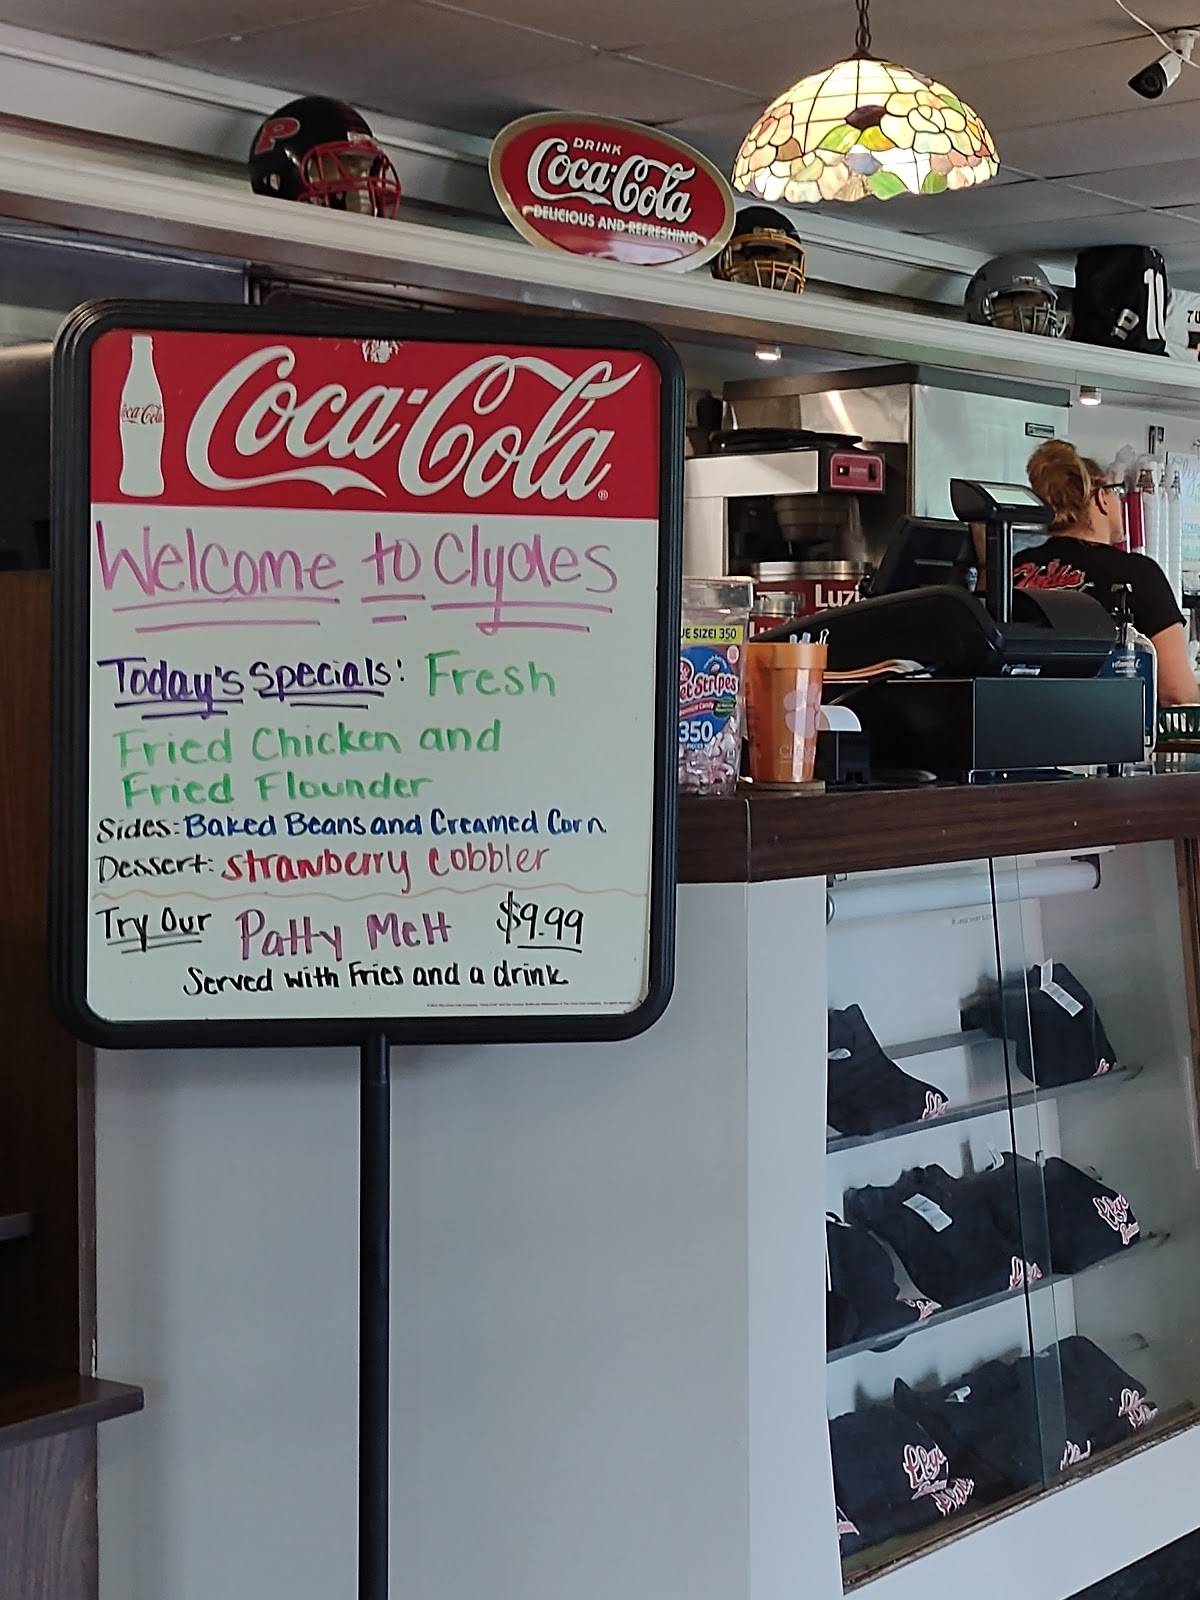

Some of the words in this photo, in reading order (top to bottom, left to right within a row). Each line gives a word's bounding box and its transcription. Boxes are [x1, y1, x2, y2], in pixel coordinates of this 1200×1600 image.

[573, 137, 622, 156] DRINK
[528, 138, 696, 224] Coca-Cola
[534, 204, 595, 227] DELICIOUS
[598, 216, 625, 232] AND
[628, 220, 698, 245] REFRESHING
[186, 345, 641, 500] Coca-Cola
[96, 520, 344, 596] Welcome
[361, 532, 421, 585] to
[434, 524, 617, 635] Clydes
[719, 627, 737, 639] 350
[97, 658, 244, 720] Today's
[249, 658, 404, 702] Specials:
[425, 650, 556, 696] Fresh
[694, 674, 738, 697] Stripes
[112, 729, 232, 768] Fried
[252, 721, 402, 761] Chicken
[419, 719, 501, 752] and
[679, 720, 713, 743] 350
[122, 771, 234, 809] Fried
[255, 771, 433, 801] Flounder
[97, 817, 180, 844] Sides:
[183, 814, 277, 839] Baked
[285, 812, 366, 837] Beans
[370, 813, 423, 836] and
[430, 808, 538, 835] Creamed
[547, 808, 607, 835] Corn
[97, 854, 214, 883] Dessert:
[95, 907, 148, 952] Try
[162, 907, 211, 933] Our
[235, 909, 343, 962] Patty
[366, 911, 452, 951] Melt
[496, 891, 584, 944] $9.99
[183, 967, 274, 996] Served
[284, 966, 340, 988] with
[349, 961, 403, 987] Fries
[413, 962, 460, 986] and
[469, 966, 485, 984] a
[493, 960, 569, 986] drink
